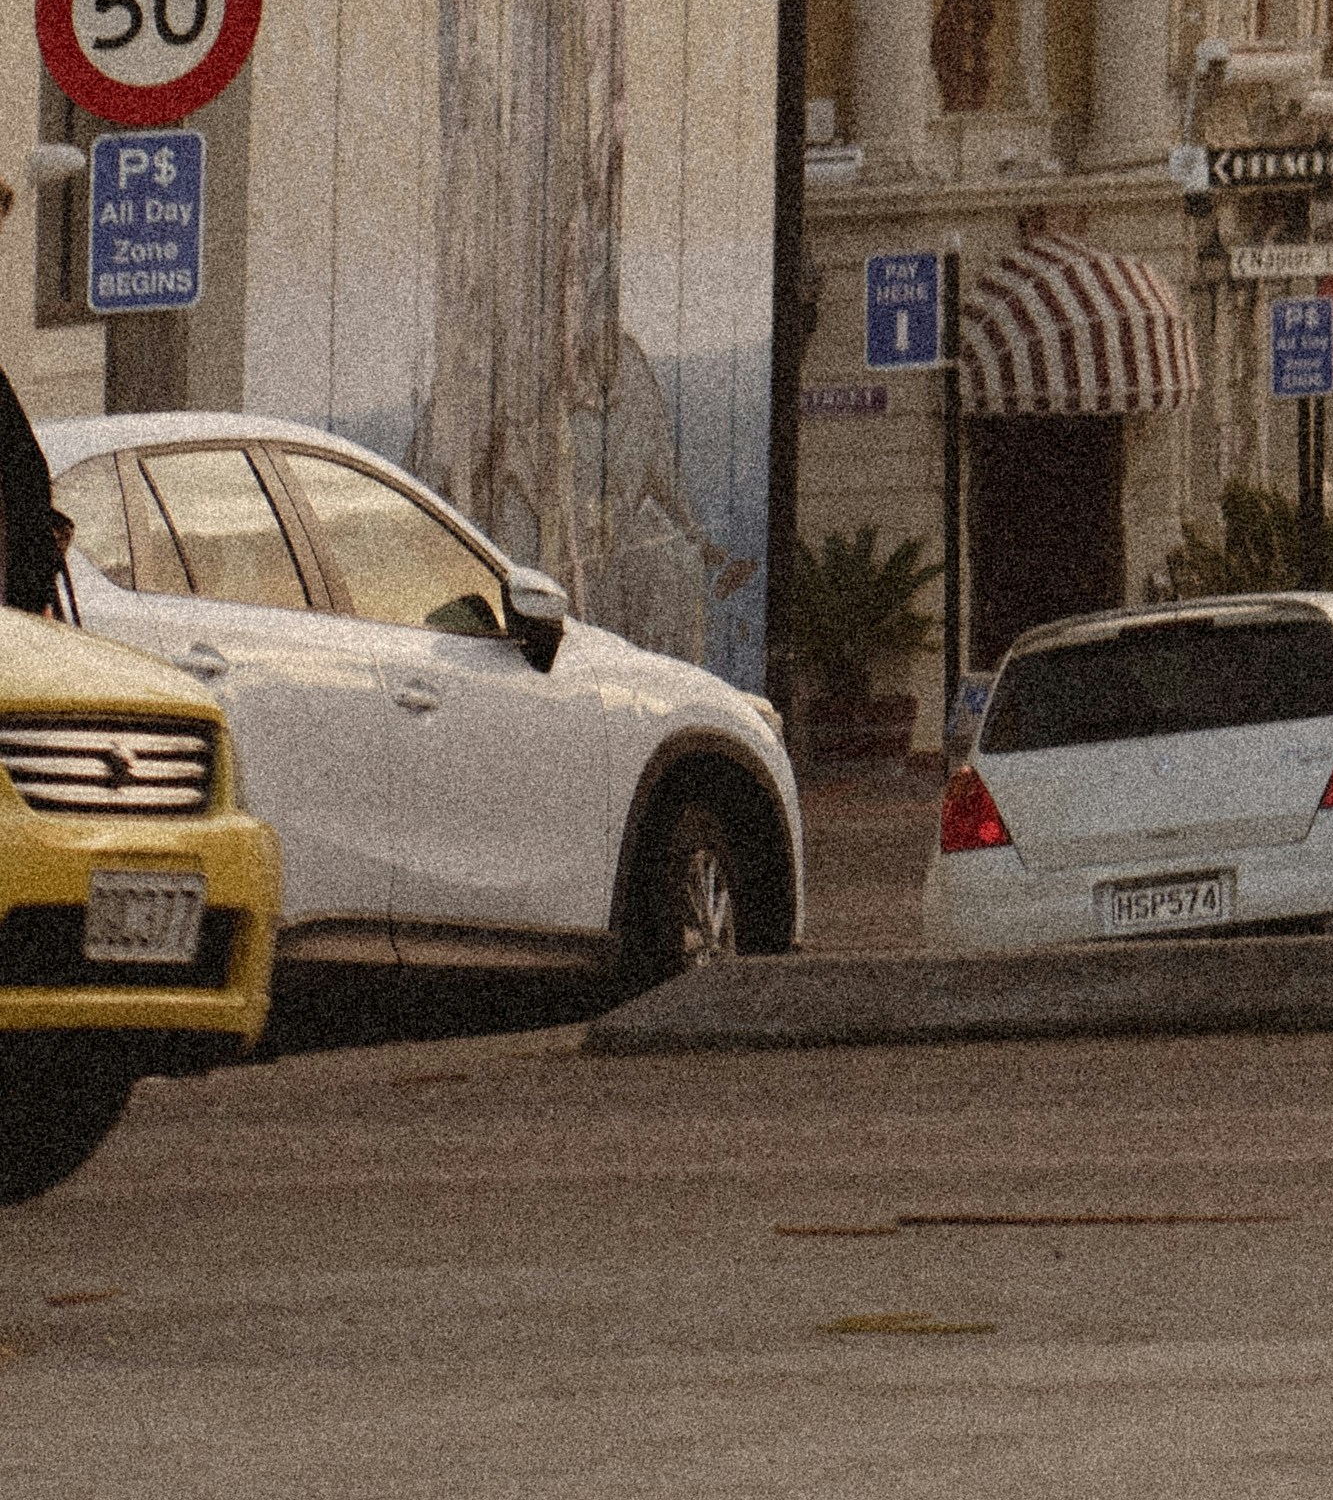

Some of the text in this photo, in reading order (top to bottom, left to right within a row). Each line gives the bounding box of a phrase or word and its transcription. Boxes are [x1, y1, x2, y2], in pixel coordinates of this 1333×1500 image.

[118, 147, 178, 189] P$
[99, 199, 193, 226] All Day
[113, 237, 179, 265] Zone
[98, 268, 193, 297] BEGINS
[885, 262, 920, 279] PAY
[876, 283, 929, 303] HERE
[1116, 884, 1217, 921] HSP574
